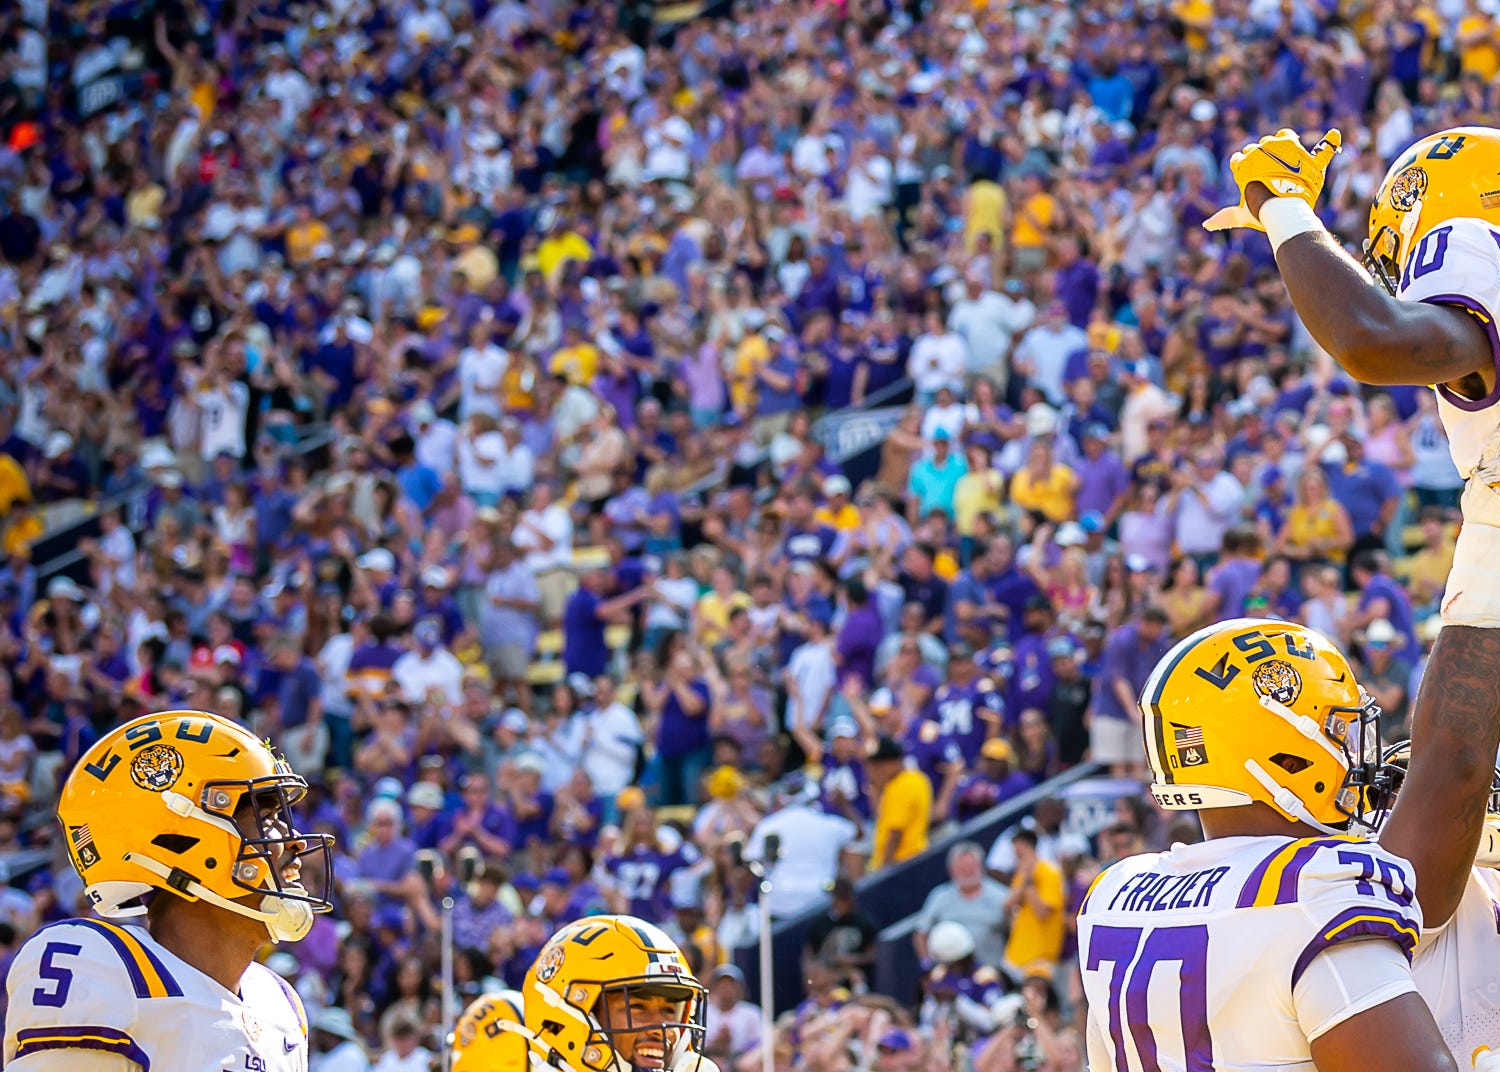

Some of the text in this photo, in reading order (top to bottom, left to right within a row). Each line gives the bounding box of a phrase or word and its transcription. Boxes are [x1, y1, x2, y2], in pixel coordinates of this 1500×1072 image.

[1194, 631, 1316, 691] LSU
[84, 719, 214, 783] LSU
[1107, 866, 1231, 912] FRAZIER
[1337, 850, 1413, 908] 70
[32, 941, 82, 1008] 5
